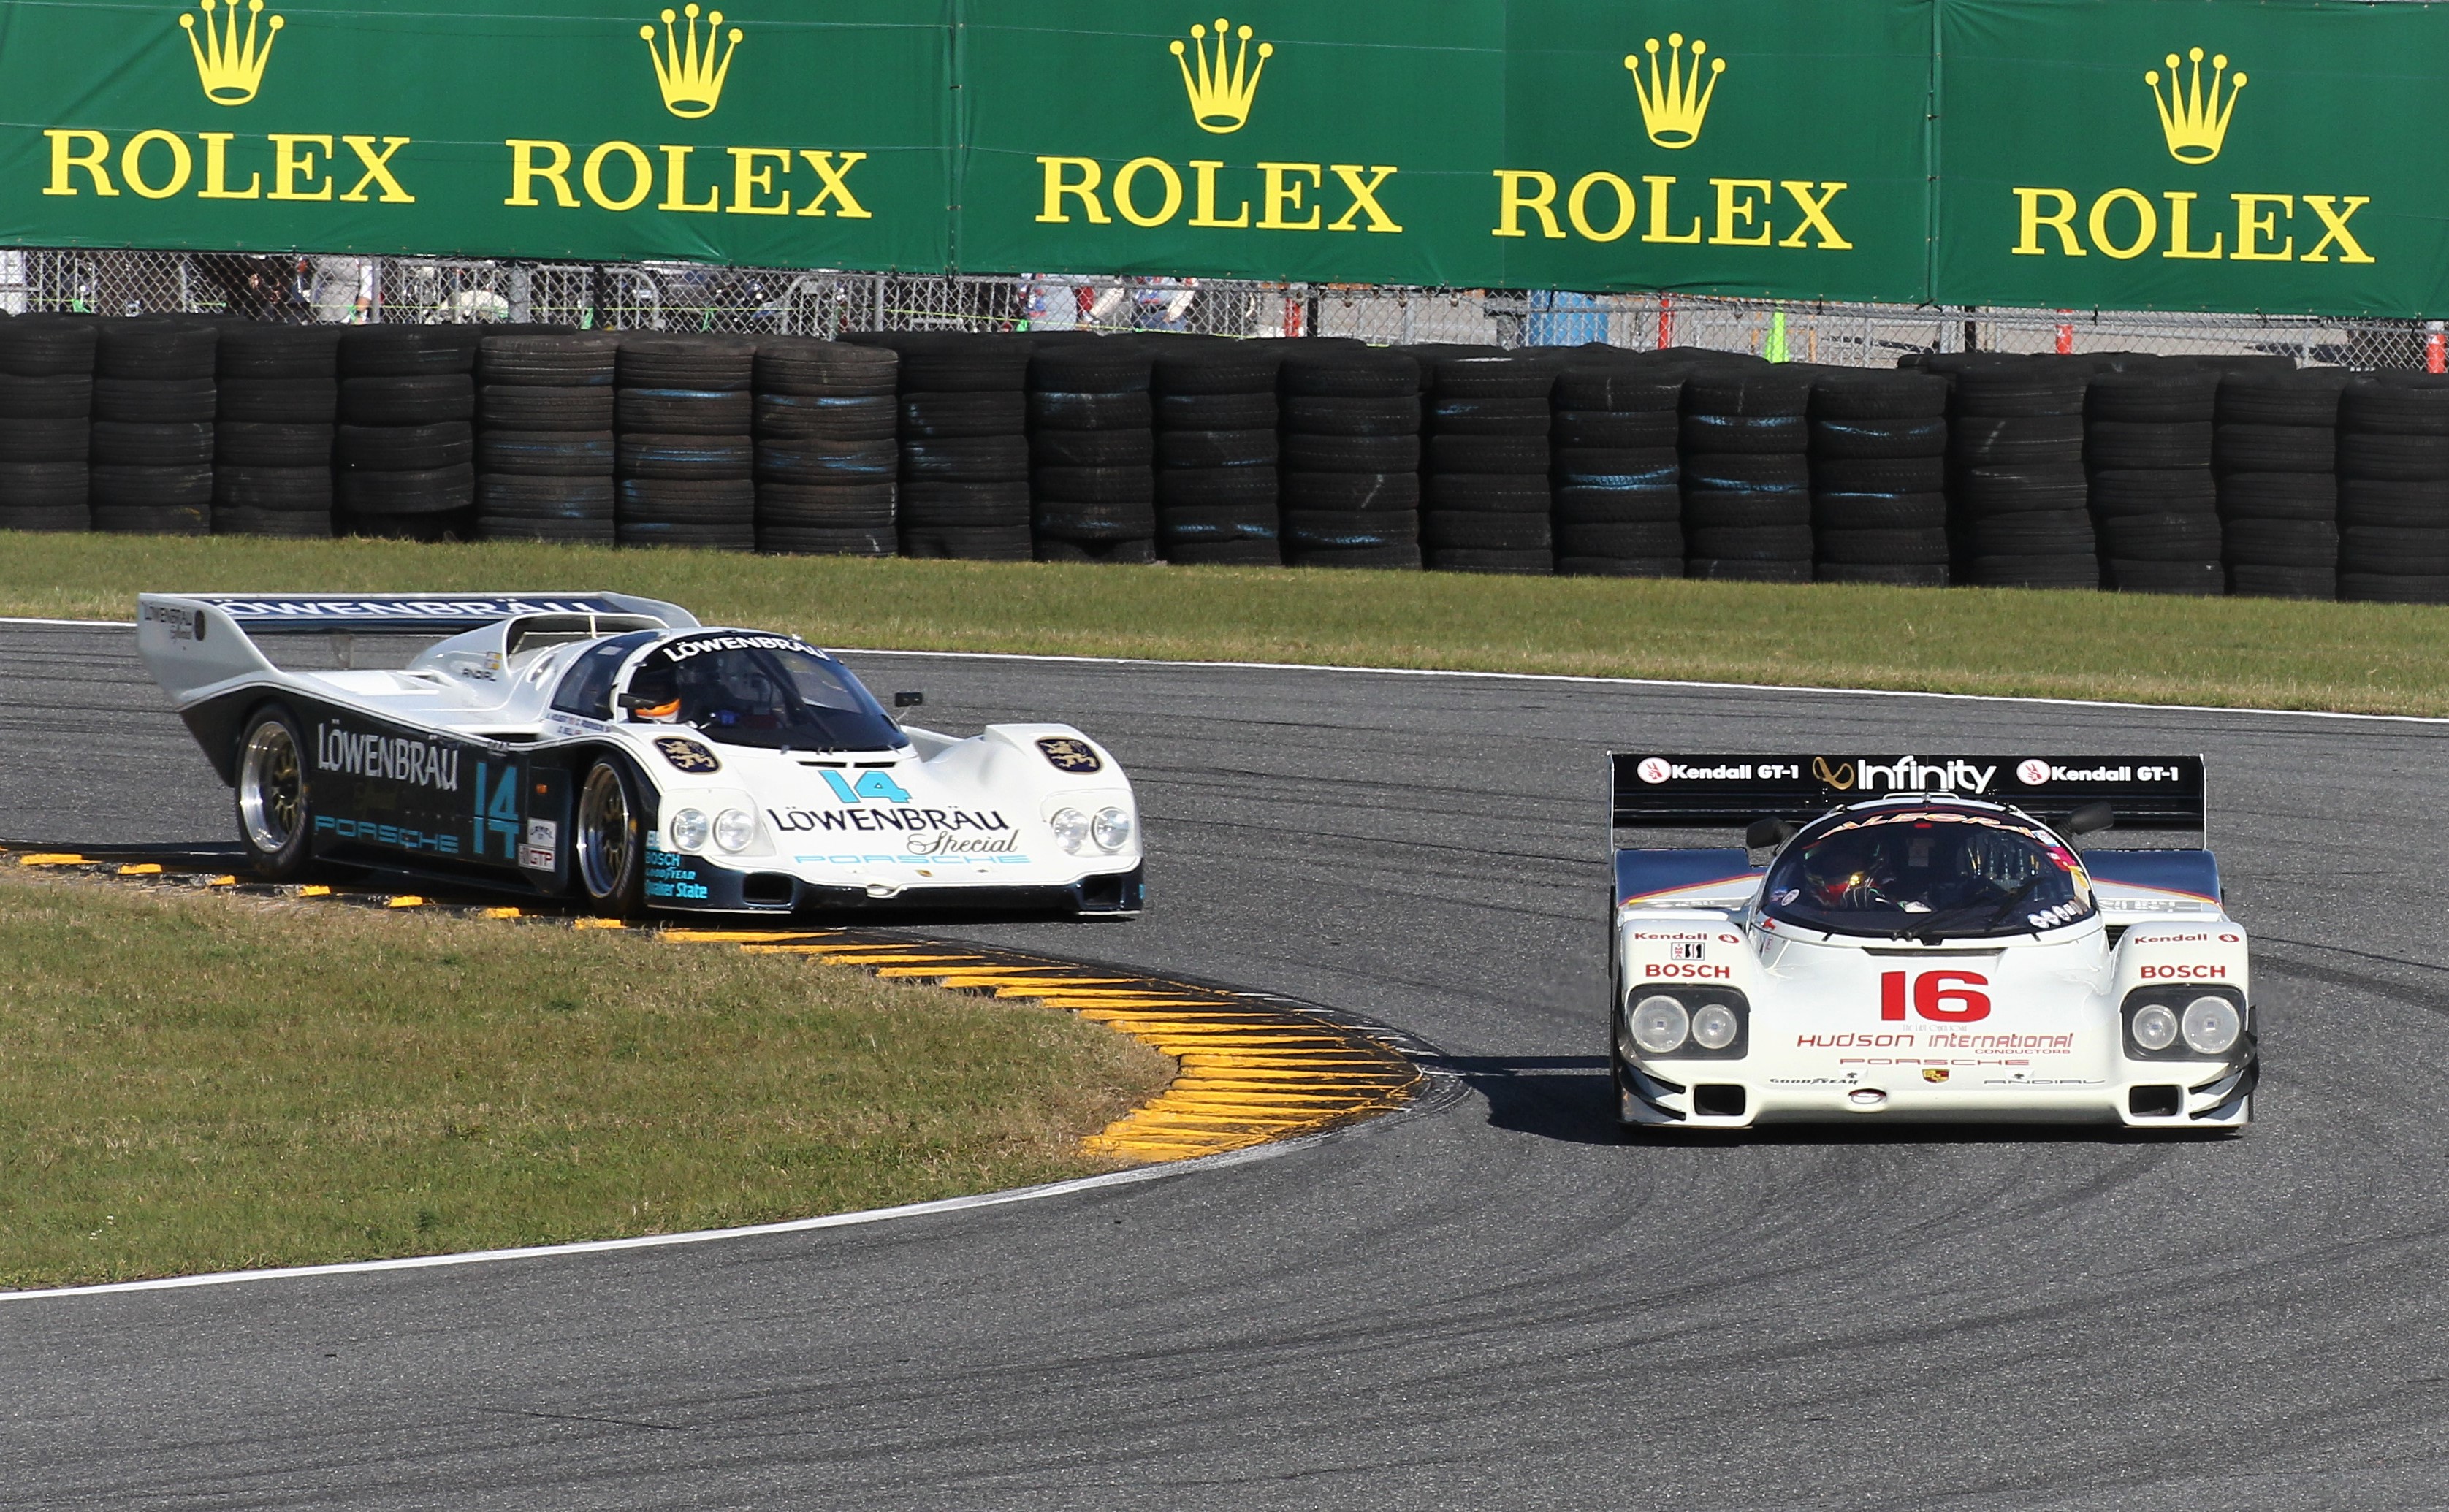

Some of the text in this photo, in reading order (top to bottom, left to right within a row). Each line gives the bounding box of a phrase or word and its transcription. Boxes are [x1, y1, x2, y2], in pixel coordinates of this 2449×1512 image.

[42, 129, 416, 204] ROLEX
[504, 139, 872, 219] ROLEX
[1035, 156, 1403, 233] ROLEX
[1491, 169, 1854, 250] ROLEX
[2011, 187, 2376, 264] ROLEX
[217, 598, 601, 617] ÖWENBRÄU
[662, 633, 831, 663] LÖWENBRÄU
[316, 718, 459, 793] LÖWENBRÄU
[1671, 764, 1799, 780] Kendall GT-1
[1858, 755, 1997, 794] Infinity
[2051, 765, 2179, 782] Kendall GT-1
[818, 769, 913, 804] 14
[473, 761, 519, 860] 14
[766, 806, 1010, 832] LÖWENBRÄU
[314, 814, 460, 854] PORSCHE
[906, 828, 1020, 855] Special
[530, 849, 553, 866] GTP
[645, 851, 681, 866] BOSCH
[794, 855, 1032, 864] PORSCHE
[675, 882, 708, 899] State
[1634, 932, 1708, 941] Kendall
[2134, 933, 2208, 944] Kendall
[1645, 963, 1730, 979] BOSCH
[2140, 965, 2226, 979] BOSCH
[1881, 969, 1992, 1023] 16
[1796, 1032, 2074, 1049] Hudson International
[1839, 1058, 2030, 1066] PORSCHE
[1769, 1077, 1859, 1085] GOODYEAR
